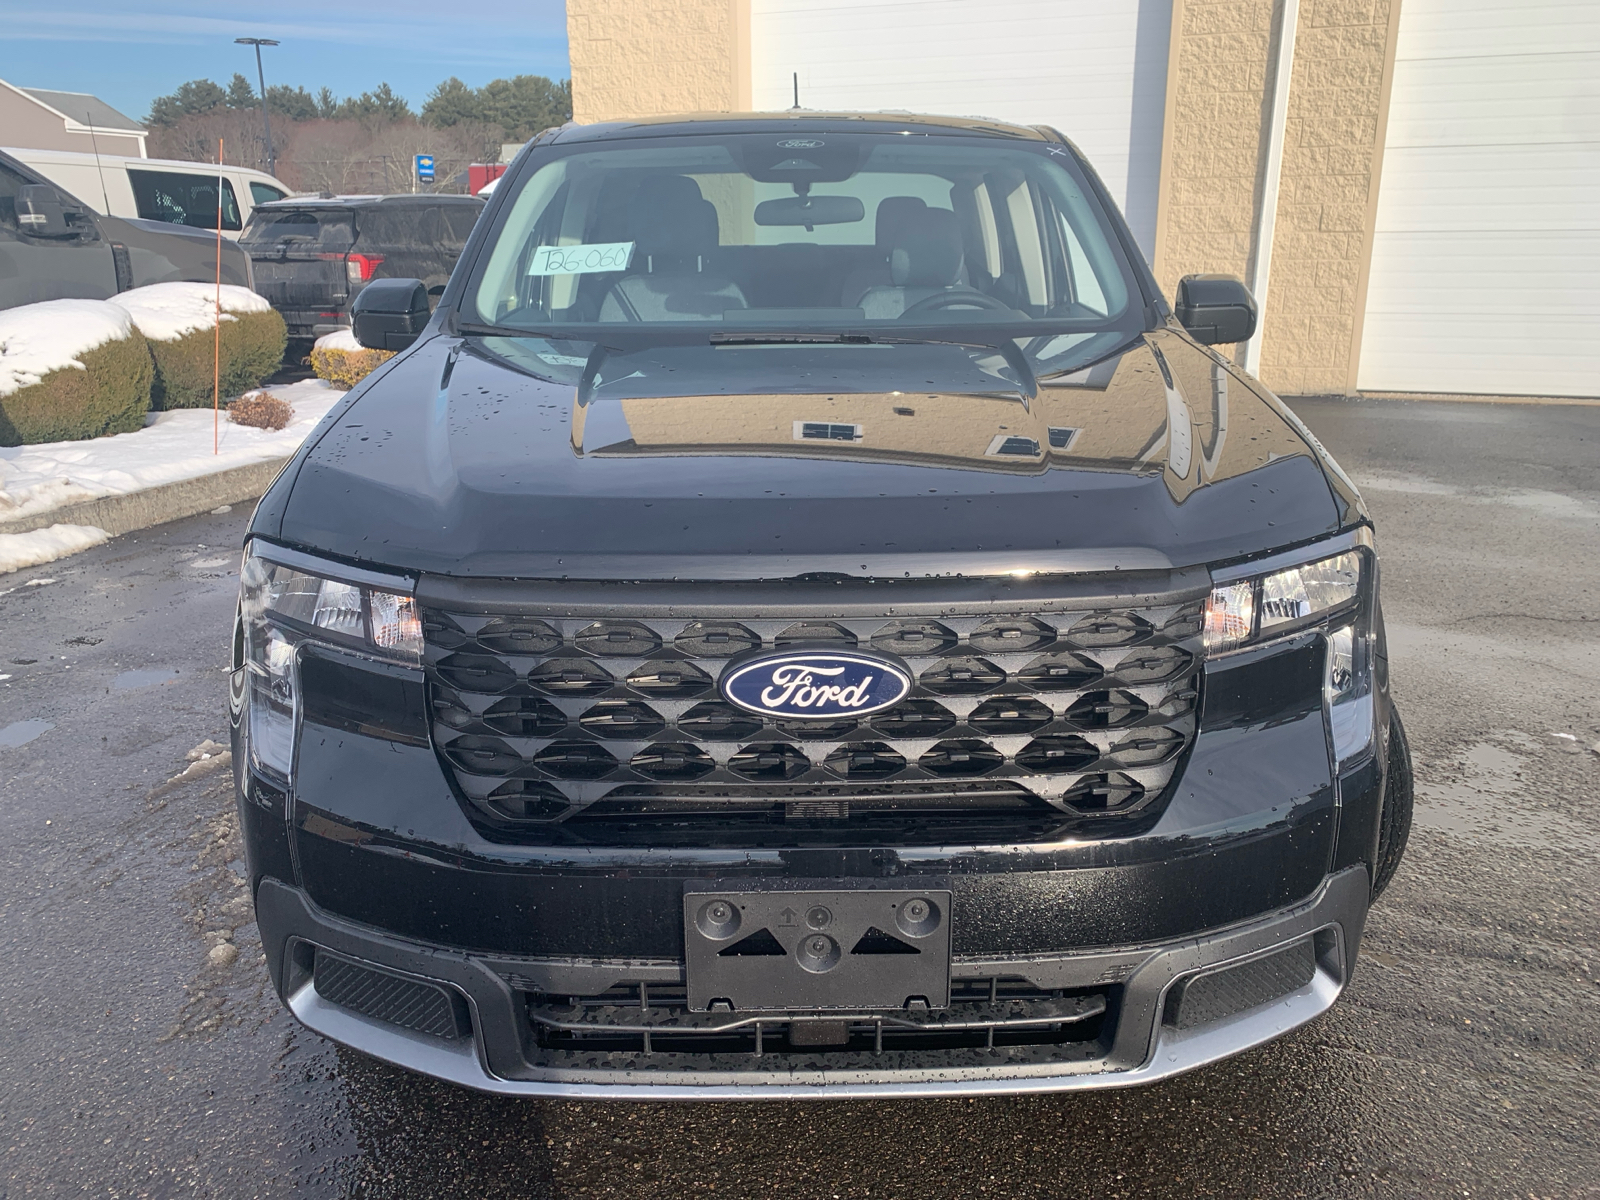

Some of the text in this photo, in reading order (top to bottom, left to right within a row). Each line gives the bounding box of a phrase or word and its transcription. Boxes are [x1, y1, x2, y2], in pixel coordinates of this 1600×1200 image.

[785, 140, 816, 148] Ford
[540, 247, 626, 272] T26-060
[761, 664, 873, 708] Ford
